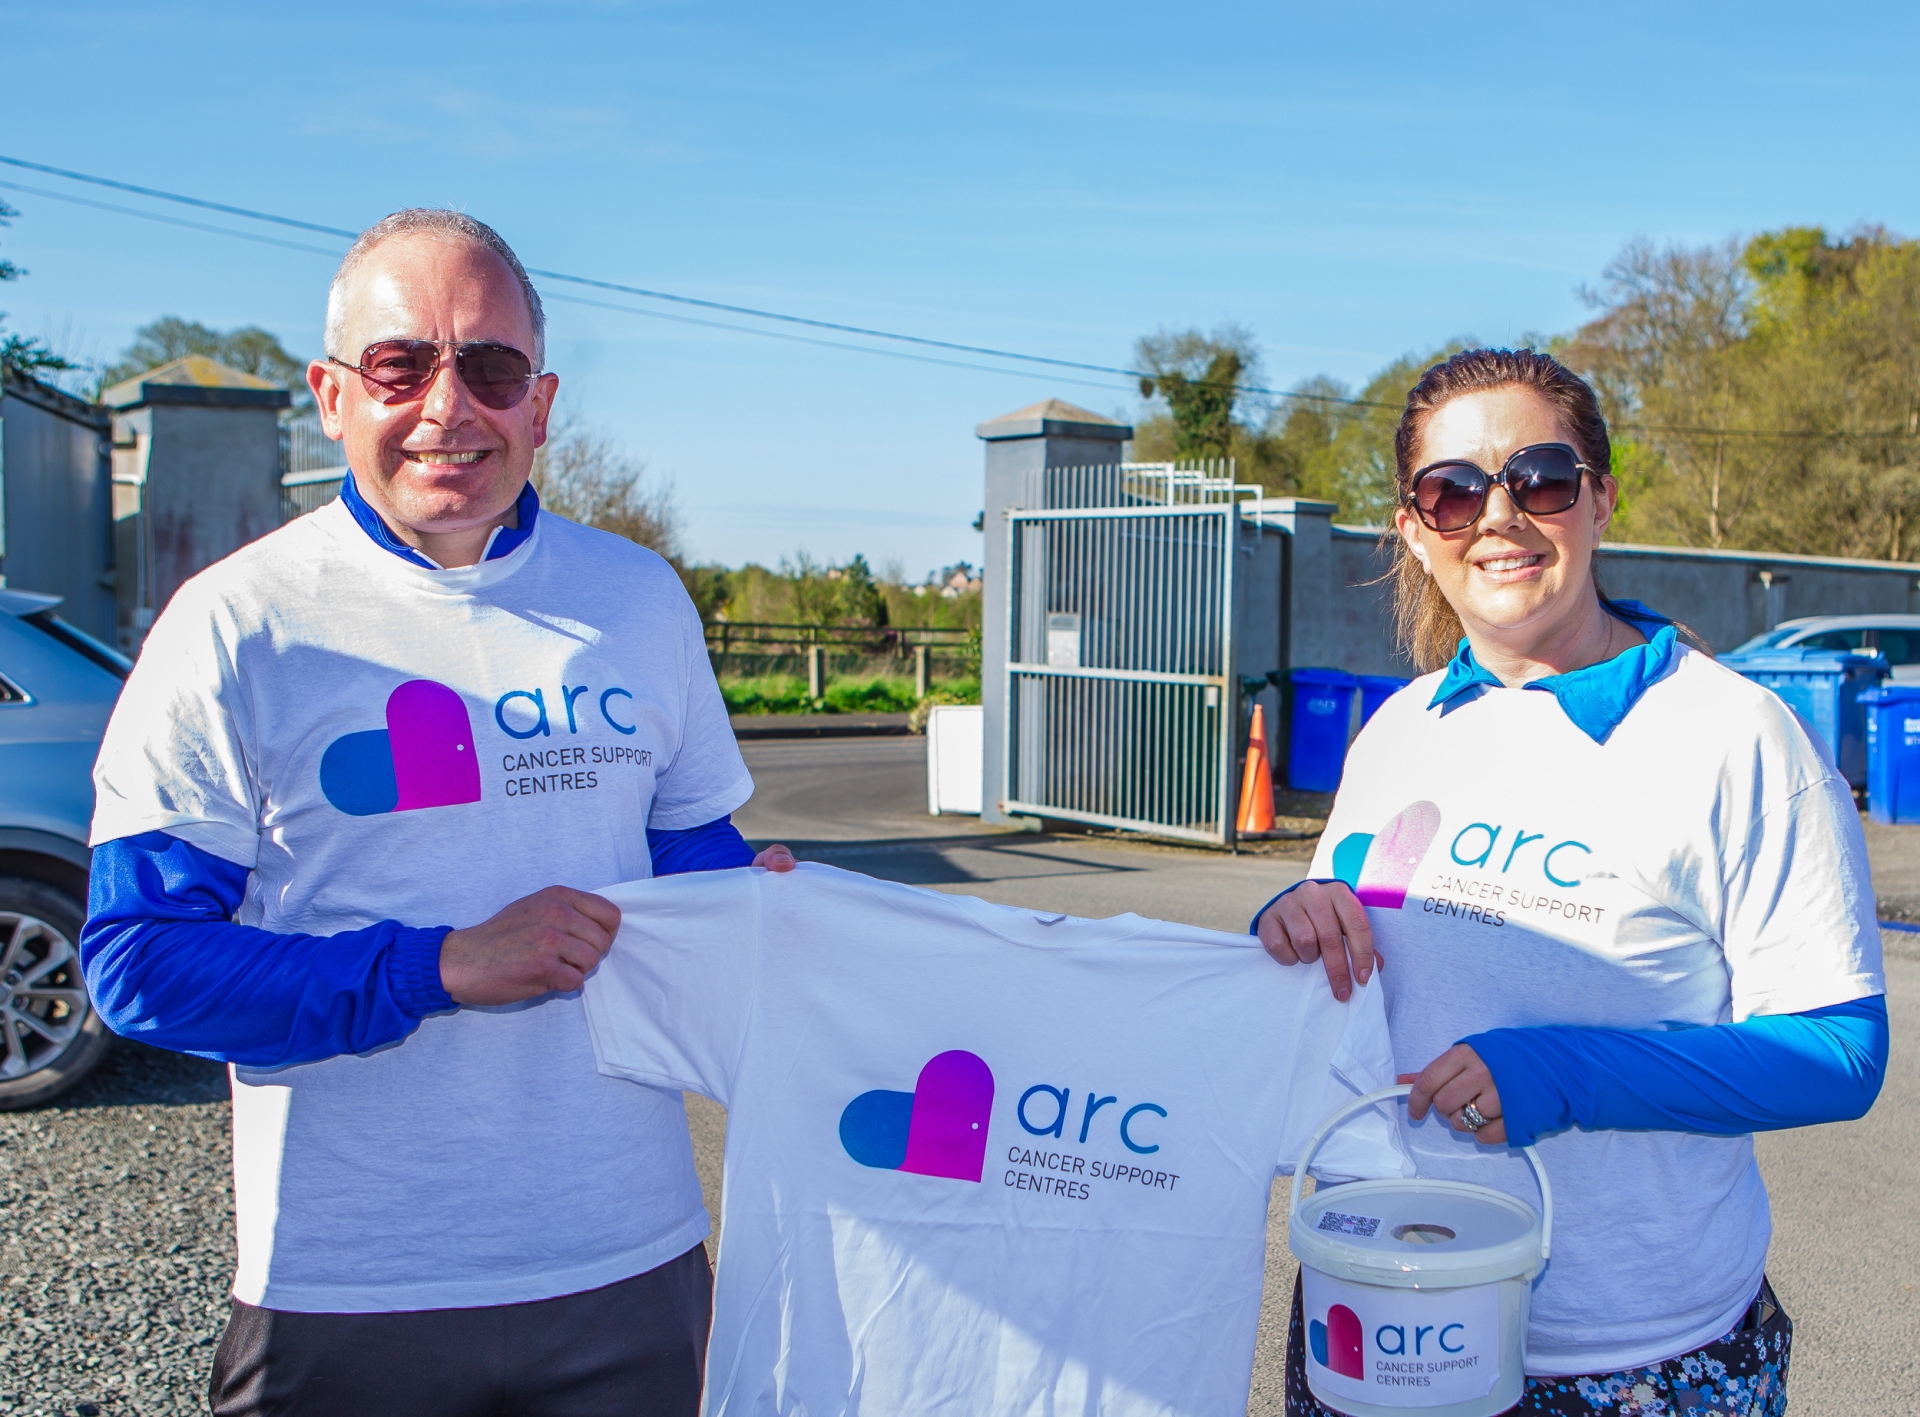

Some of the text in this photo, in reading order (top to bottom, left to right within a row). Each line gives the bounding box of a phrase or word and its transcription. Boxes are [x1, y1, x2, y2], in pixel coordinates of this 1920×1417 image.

[495, 685, 637, 740] arc
[503, 747, 653, 772] CANCER SUPPORT
[505, 772, 598, 797] CENTRES
[1451, 823, 1593, 887] arc
[1423, 897, 1506, 927] CENTRES
[1431, 875, 1605, 924] CANCER SUPPORT
[1017, 1084, 1168, 1154] arc
[1007, 1146, 1180, 1191] CANCER SUPPORT
[1004, 1170, 1090, 1200] CENTRES
[1375, 1323, 1465, 1356] arc
[1376, 1356, 1480, 1373] CANCER SUPPORT
[1376, 1374, 1431, 1387] CENTRES
